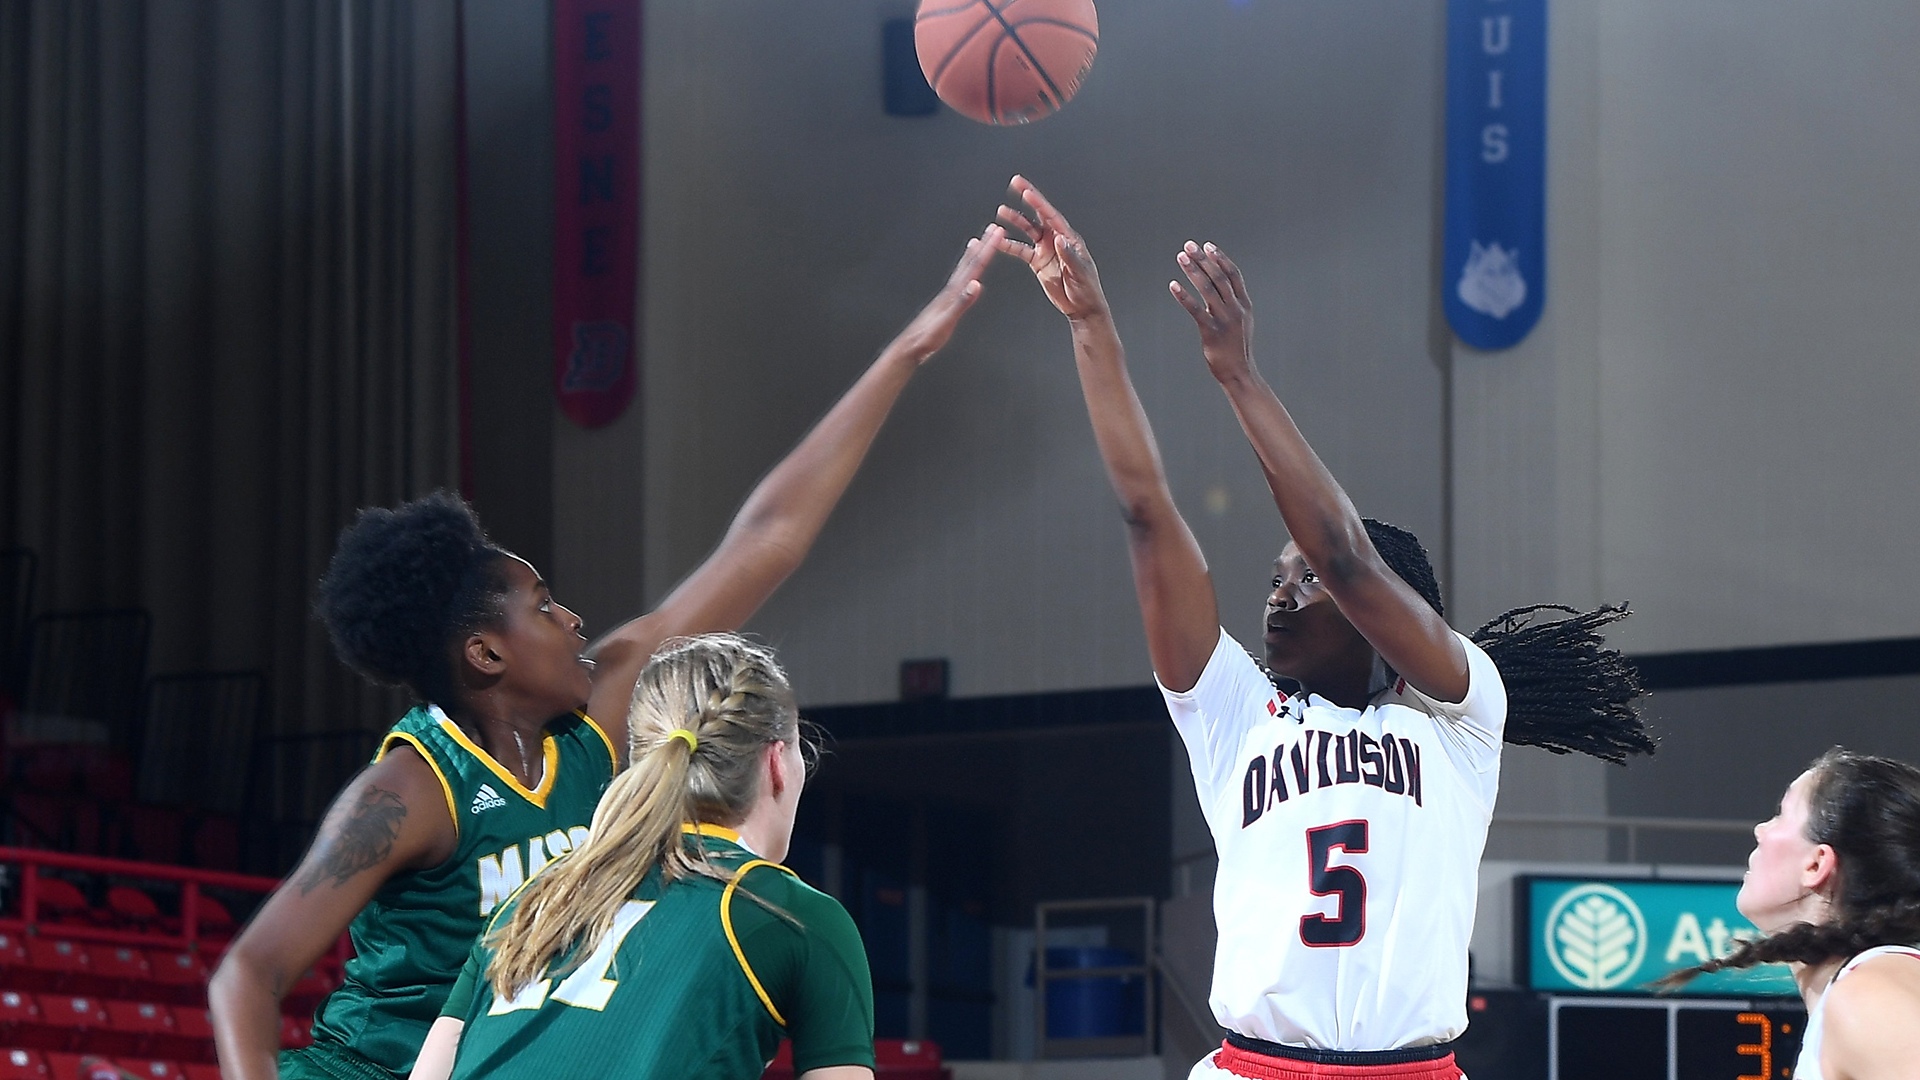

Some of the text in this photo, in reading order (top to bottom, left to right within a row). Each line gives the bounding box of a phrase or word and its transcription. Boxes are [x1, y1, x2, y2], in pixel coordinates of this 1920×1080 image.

[1482, 0, 1511, 163] UIS
[471, 797, 506, 814] adidas
[1242, 728, 1422, 829] DAVIDSON
[1300, 819, 1369, 947] 5
